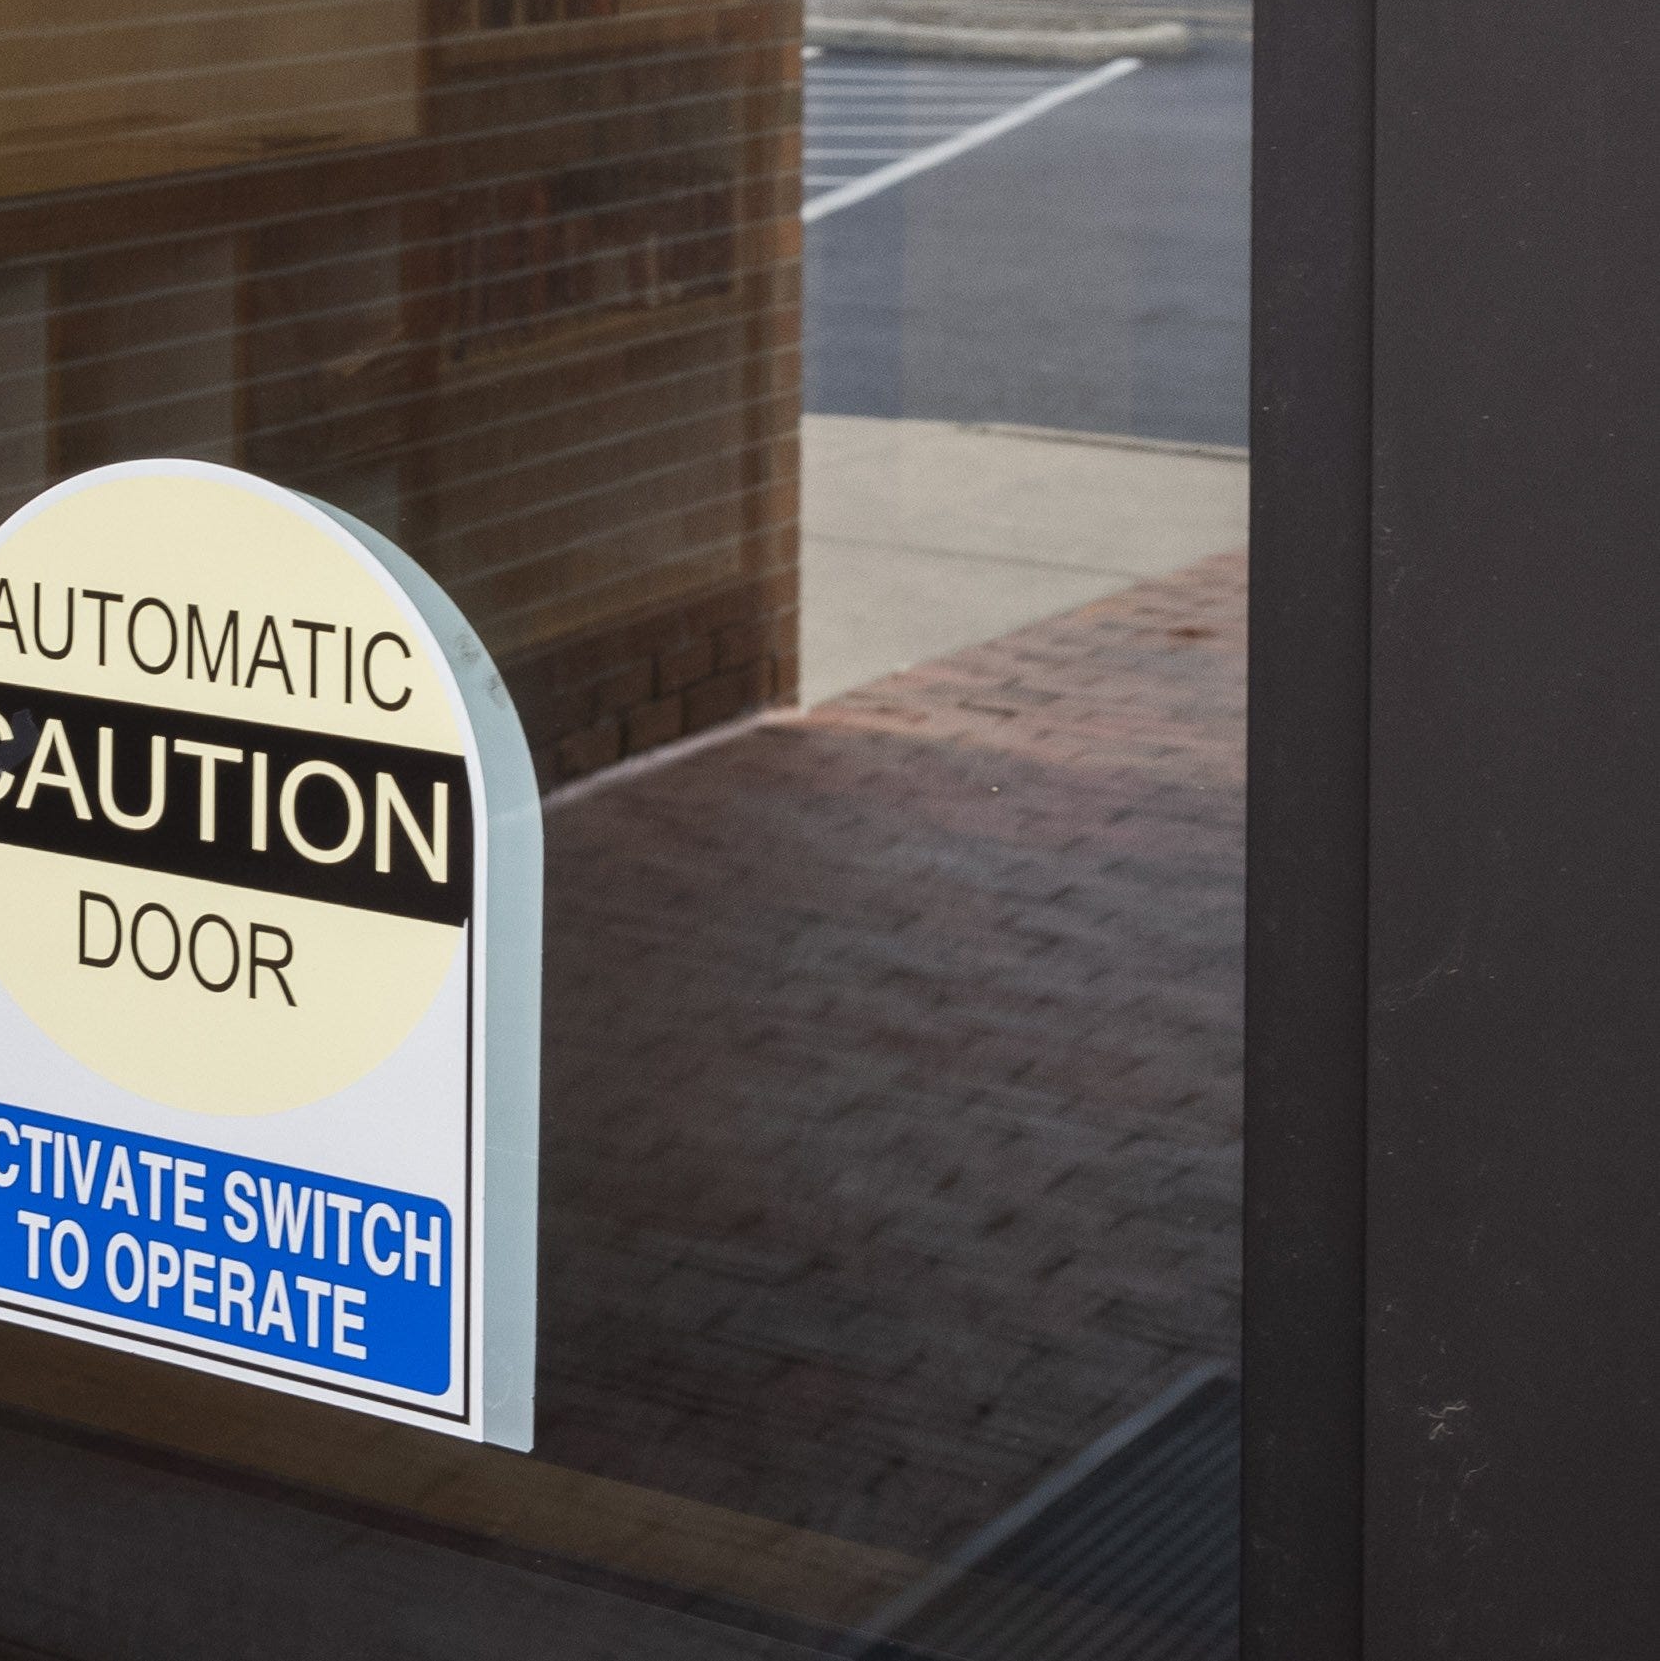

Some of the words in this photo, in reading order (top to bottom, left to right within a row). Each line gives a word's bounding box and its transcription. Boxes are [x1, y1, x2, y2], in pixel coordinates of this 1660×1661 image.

[79, 890, 297, 1007] DOOR
[17, 1209, 89, 1290] TO
[105, 1232, 368, 1360] OPERATE
[223, 1170, 442, 1287] SWITCH
